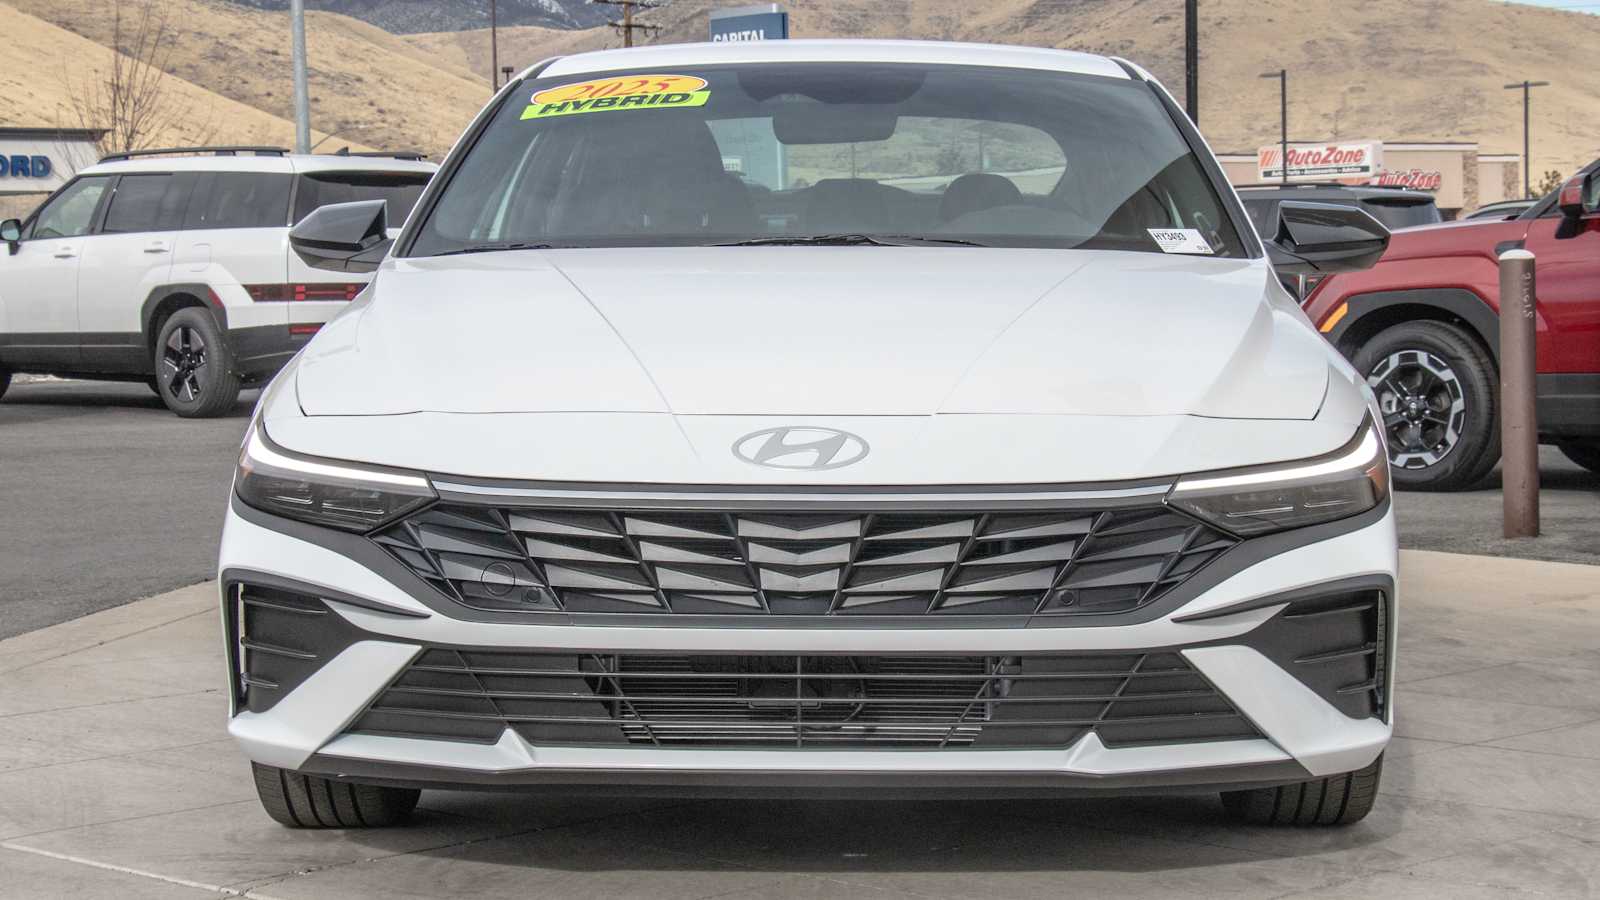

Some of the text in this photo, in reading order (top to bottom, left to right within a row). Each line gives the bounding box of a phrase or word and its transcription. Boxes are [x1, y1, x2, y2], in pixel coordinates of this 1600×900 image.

[560, 78, 682, 101] 2025
[538, 92, 692, 115] HYBRID
[1287, 147, 1365, 166] AutoZone
